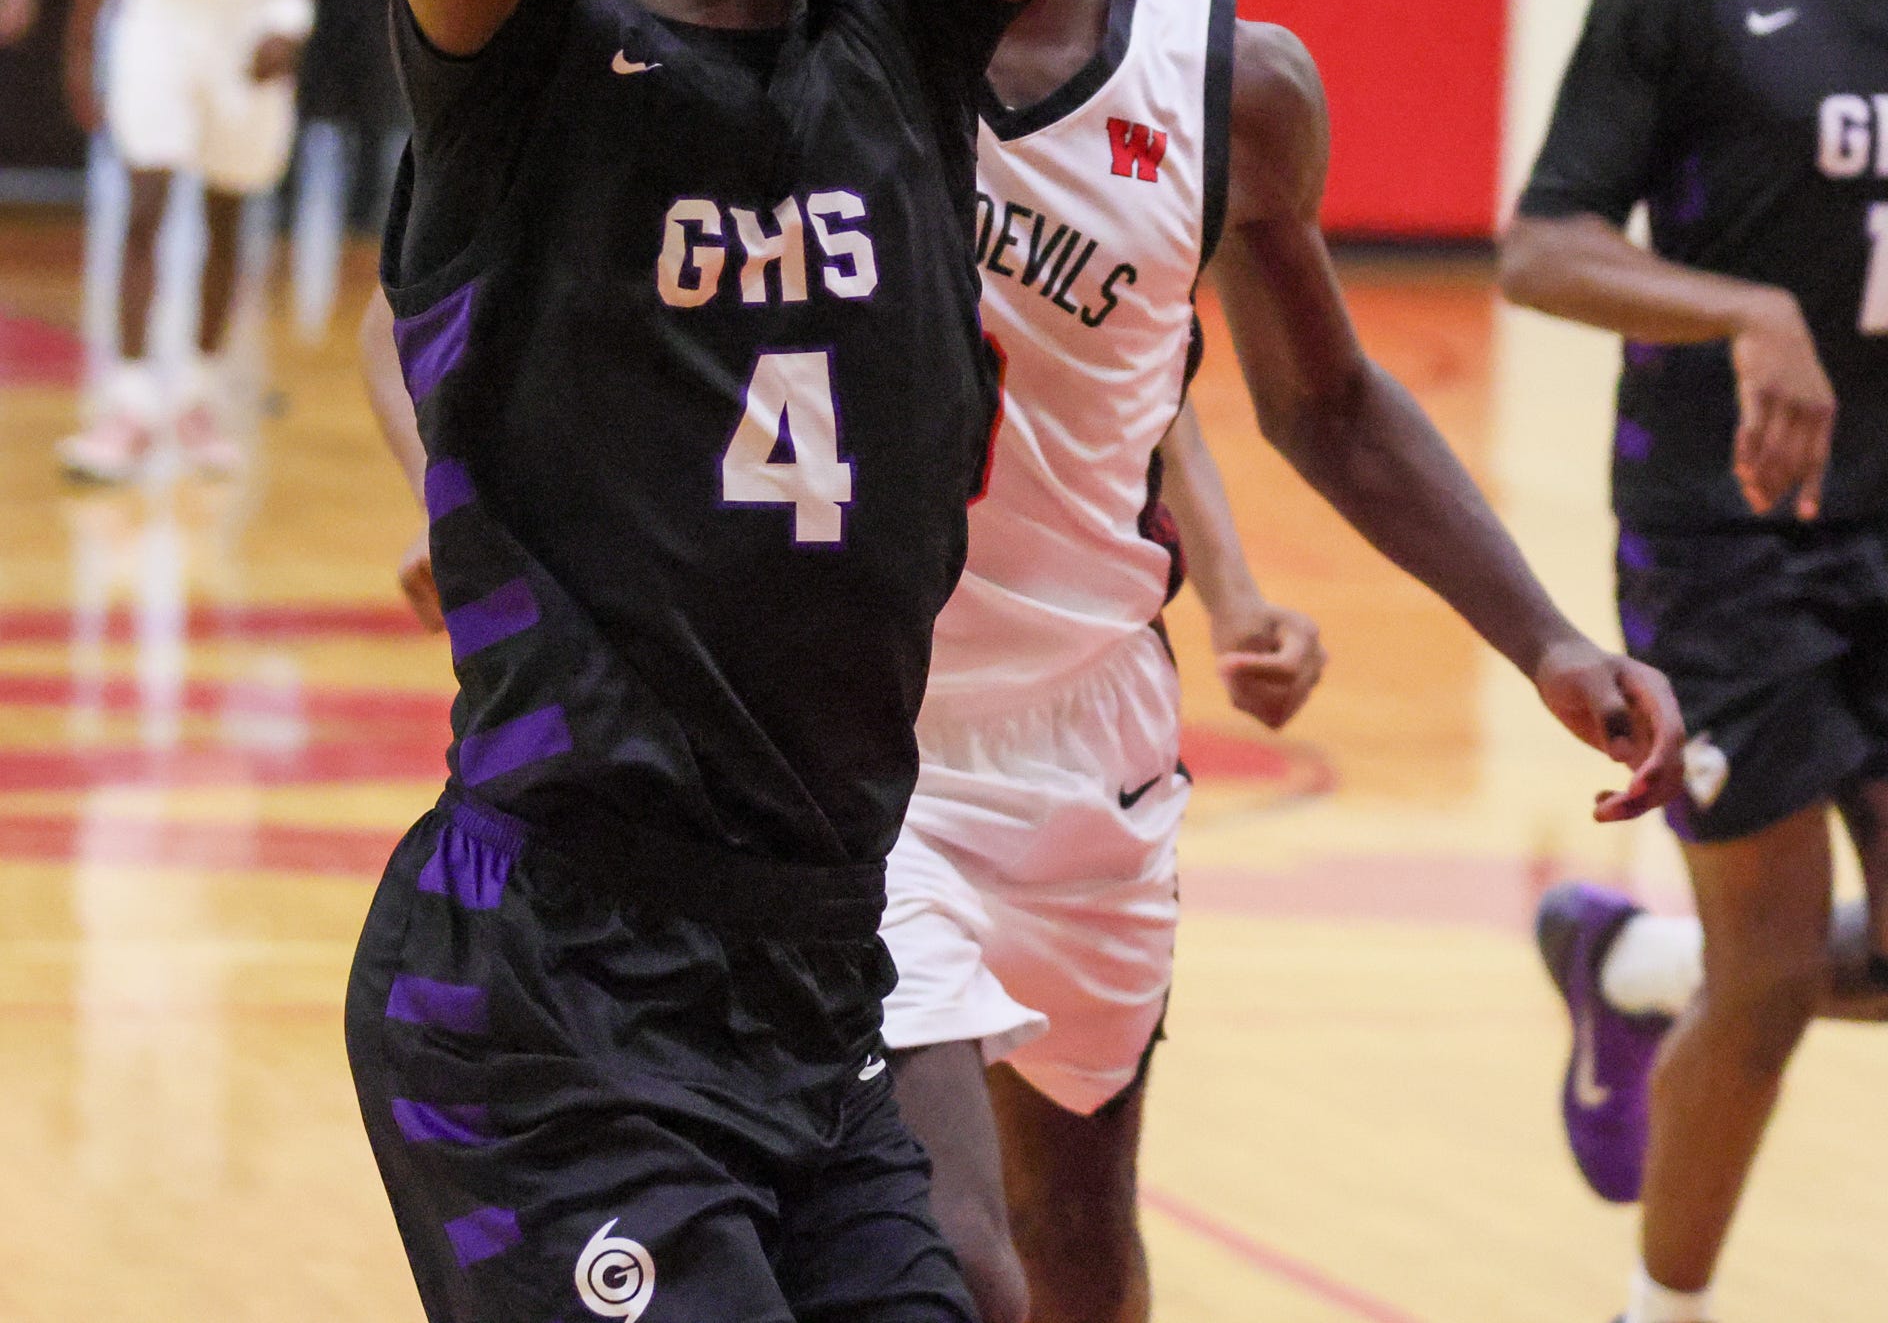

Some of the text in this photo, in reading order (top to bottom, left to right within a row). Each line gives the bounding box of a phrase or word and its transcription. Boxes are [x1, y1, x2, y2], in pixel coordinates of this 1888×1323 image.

[1106, 117, 1167, 182] W
[656, 190, 879, 308] GHS
[722, 349, 853, 543] 4
